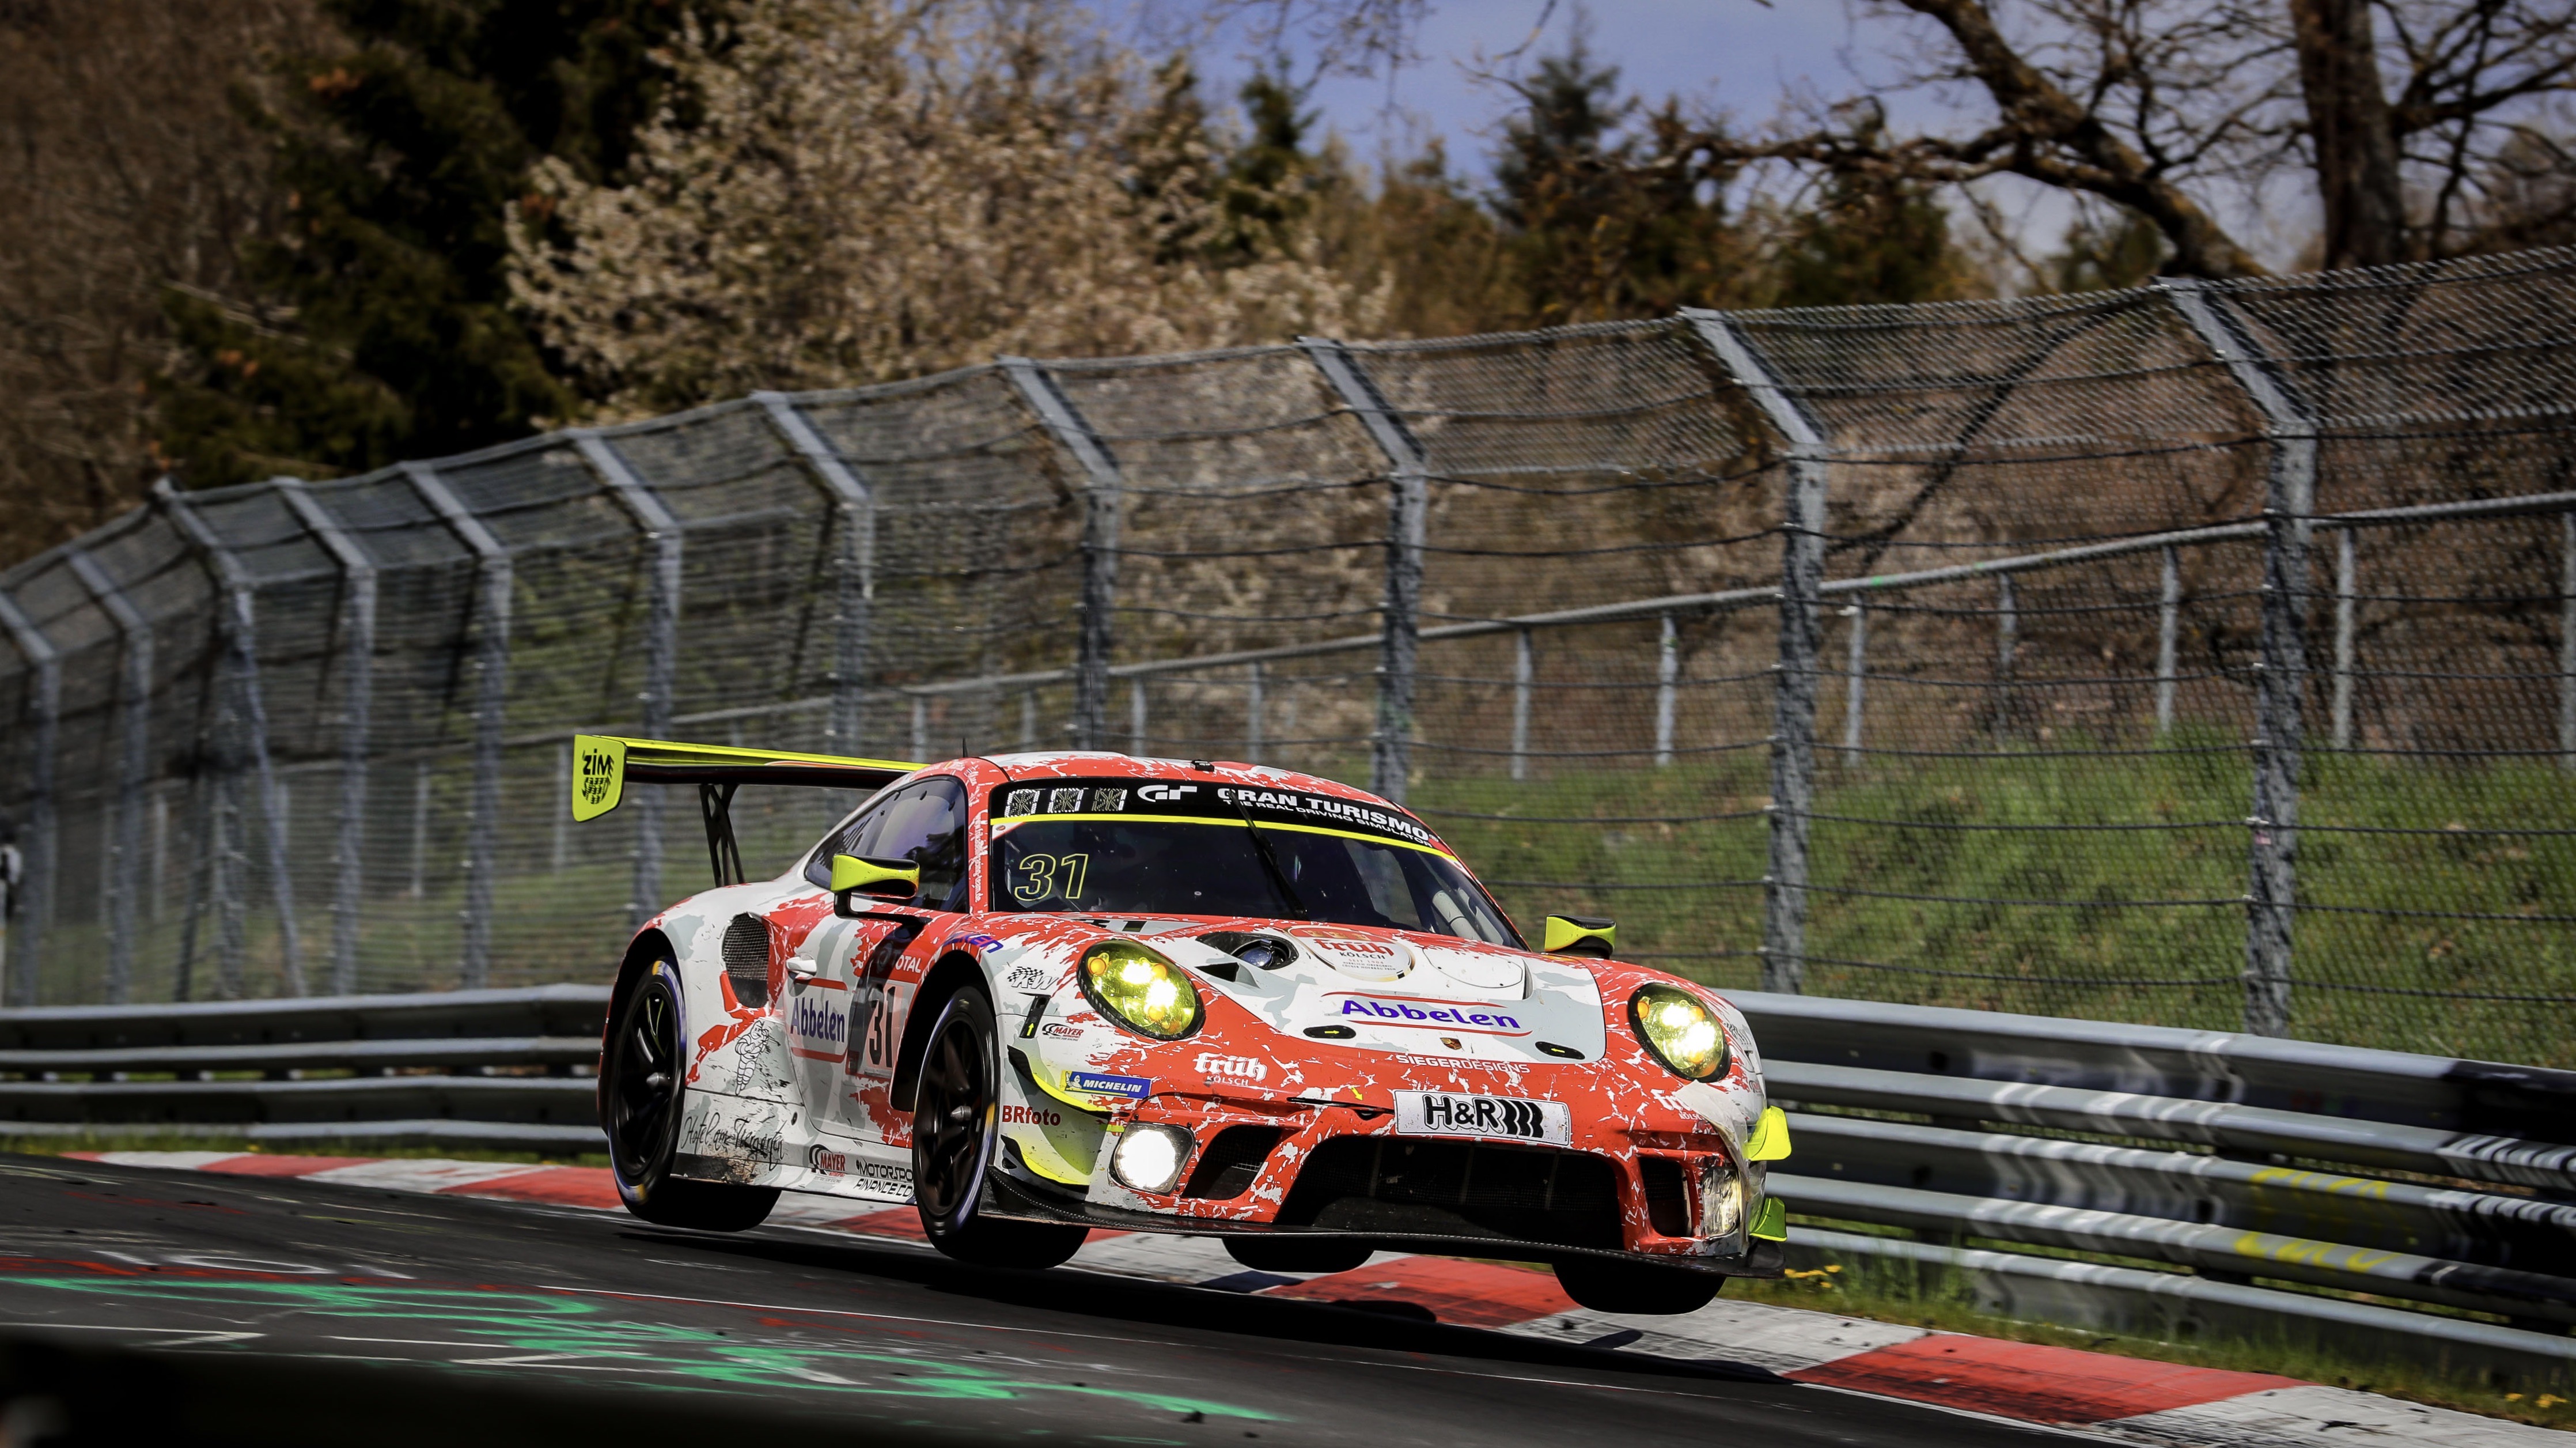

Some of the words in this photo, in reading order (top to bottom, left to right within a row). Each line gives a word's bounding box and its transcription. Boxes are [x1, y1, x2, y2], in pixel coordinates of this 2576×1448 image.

[1217, 788, 1297, 806] GRAN
[1256, 802, 1294, 811] REAL
[1295, 807, 1354, 822] DRIVING
[1357, 818, 1433, 848] SIMULATOR
[1014, 853, 1089, 901] 31
[1099, 914, 1199, 922] TOTAL
[892, 950, 922, 973] TOTAL
[1011, 974, 1059, 990] KW
[790, 997, 845, 1043] Abbelen
[1342, 1000, 1521, 1029] Abbelen
[868, 984, 896, 1068] 31
[1053, 1027, 1084, 1036] MAYER
[1396, 1054, 1531, 1073] SIEGERDESIGNS
[1083, 1079, 1142, 1092] MICHELIN
[1206, 1075, 1249, 1086] KÖLSCH
[1002, 1105, 1061, 1126] BRfoto
[1423, 1095, 1502, 1132] H&R
[1679, 1112, 1707, 1120] KÖLSC
[820, 1152, 846, 1172] MAYER
[859, 1160, 913, 1182] MOTORSPO
[853, 1178, 914, 1198] FINANCE.CO
